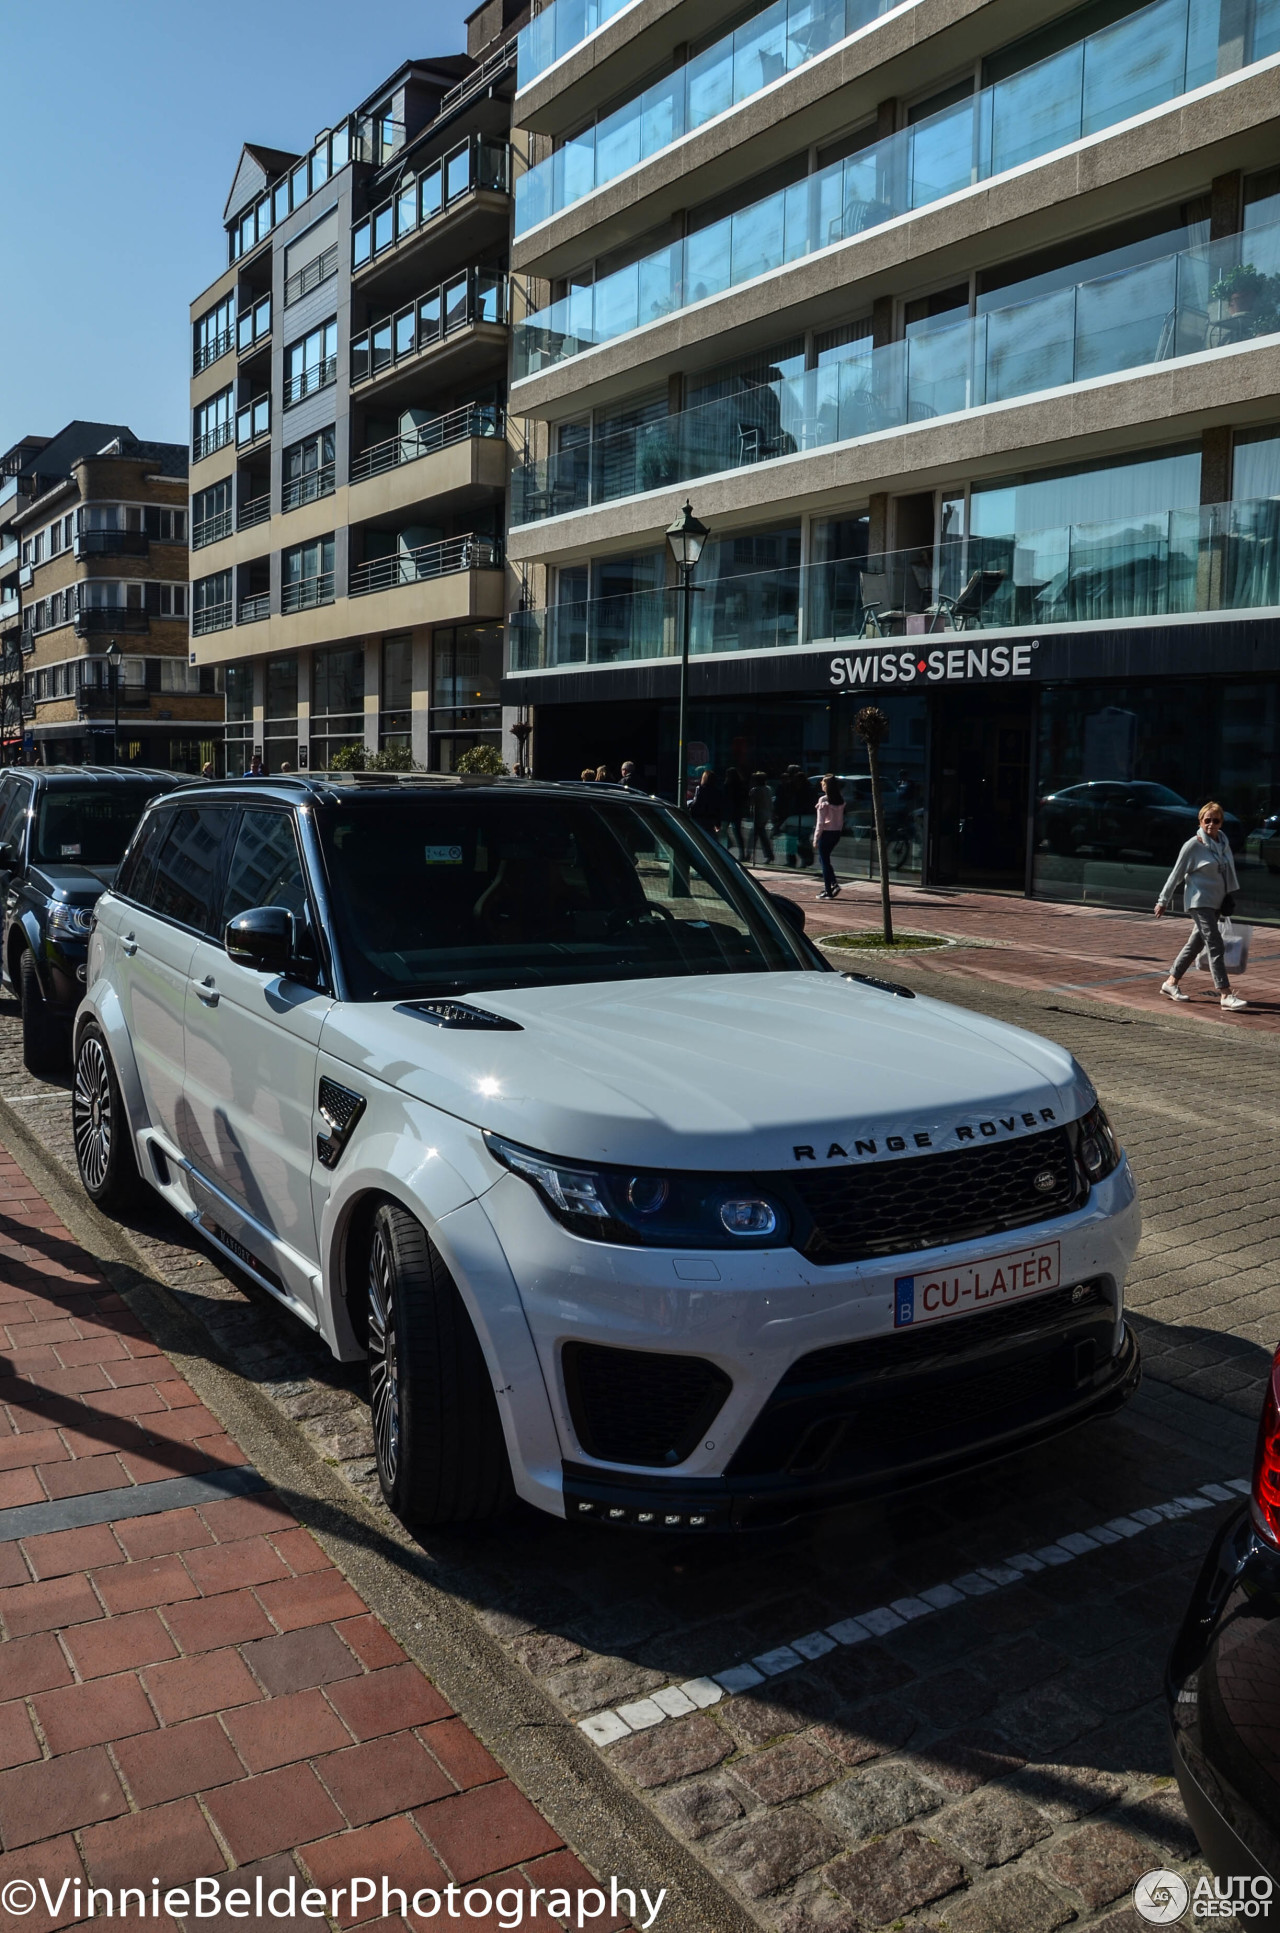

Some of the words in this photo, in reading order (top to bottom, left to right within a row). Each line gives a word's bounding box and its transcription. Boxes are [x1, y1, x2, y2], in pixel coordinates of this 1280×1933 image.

[829, 653, 916, 685] SWISS
[927, 646, 1032, 681] SENSE
[24, 732, 32, 742] P
[793, 1133, 932, 1160] RANGE
[955, 1108, 1056, 1141] ROVER
[923, 1256, 1052, 1312] CU-LATER
[900, 1304, 912, 1321] B
